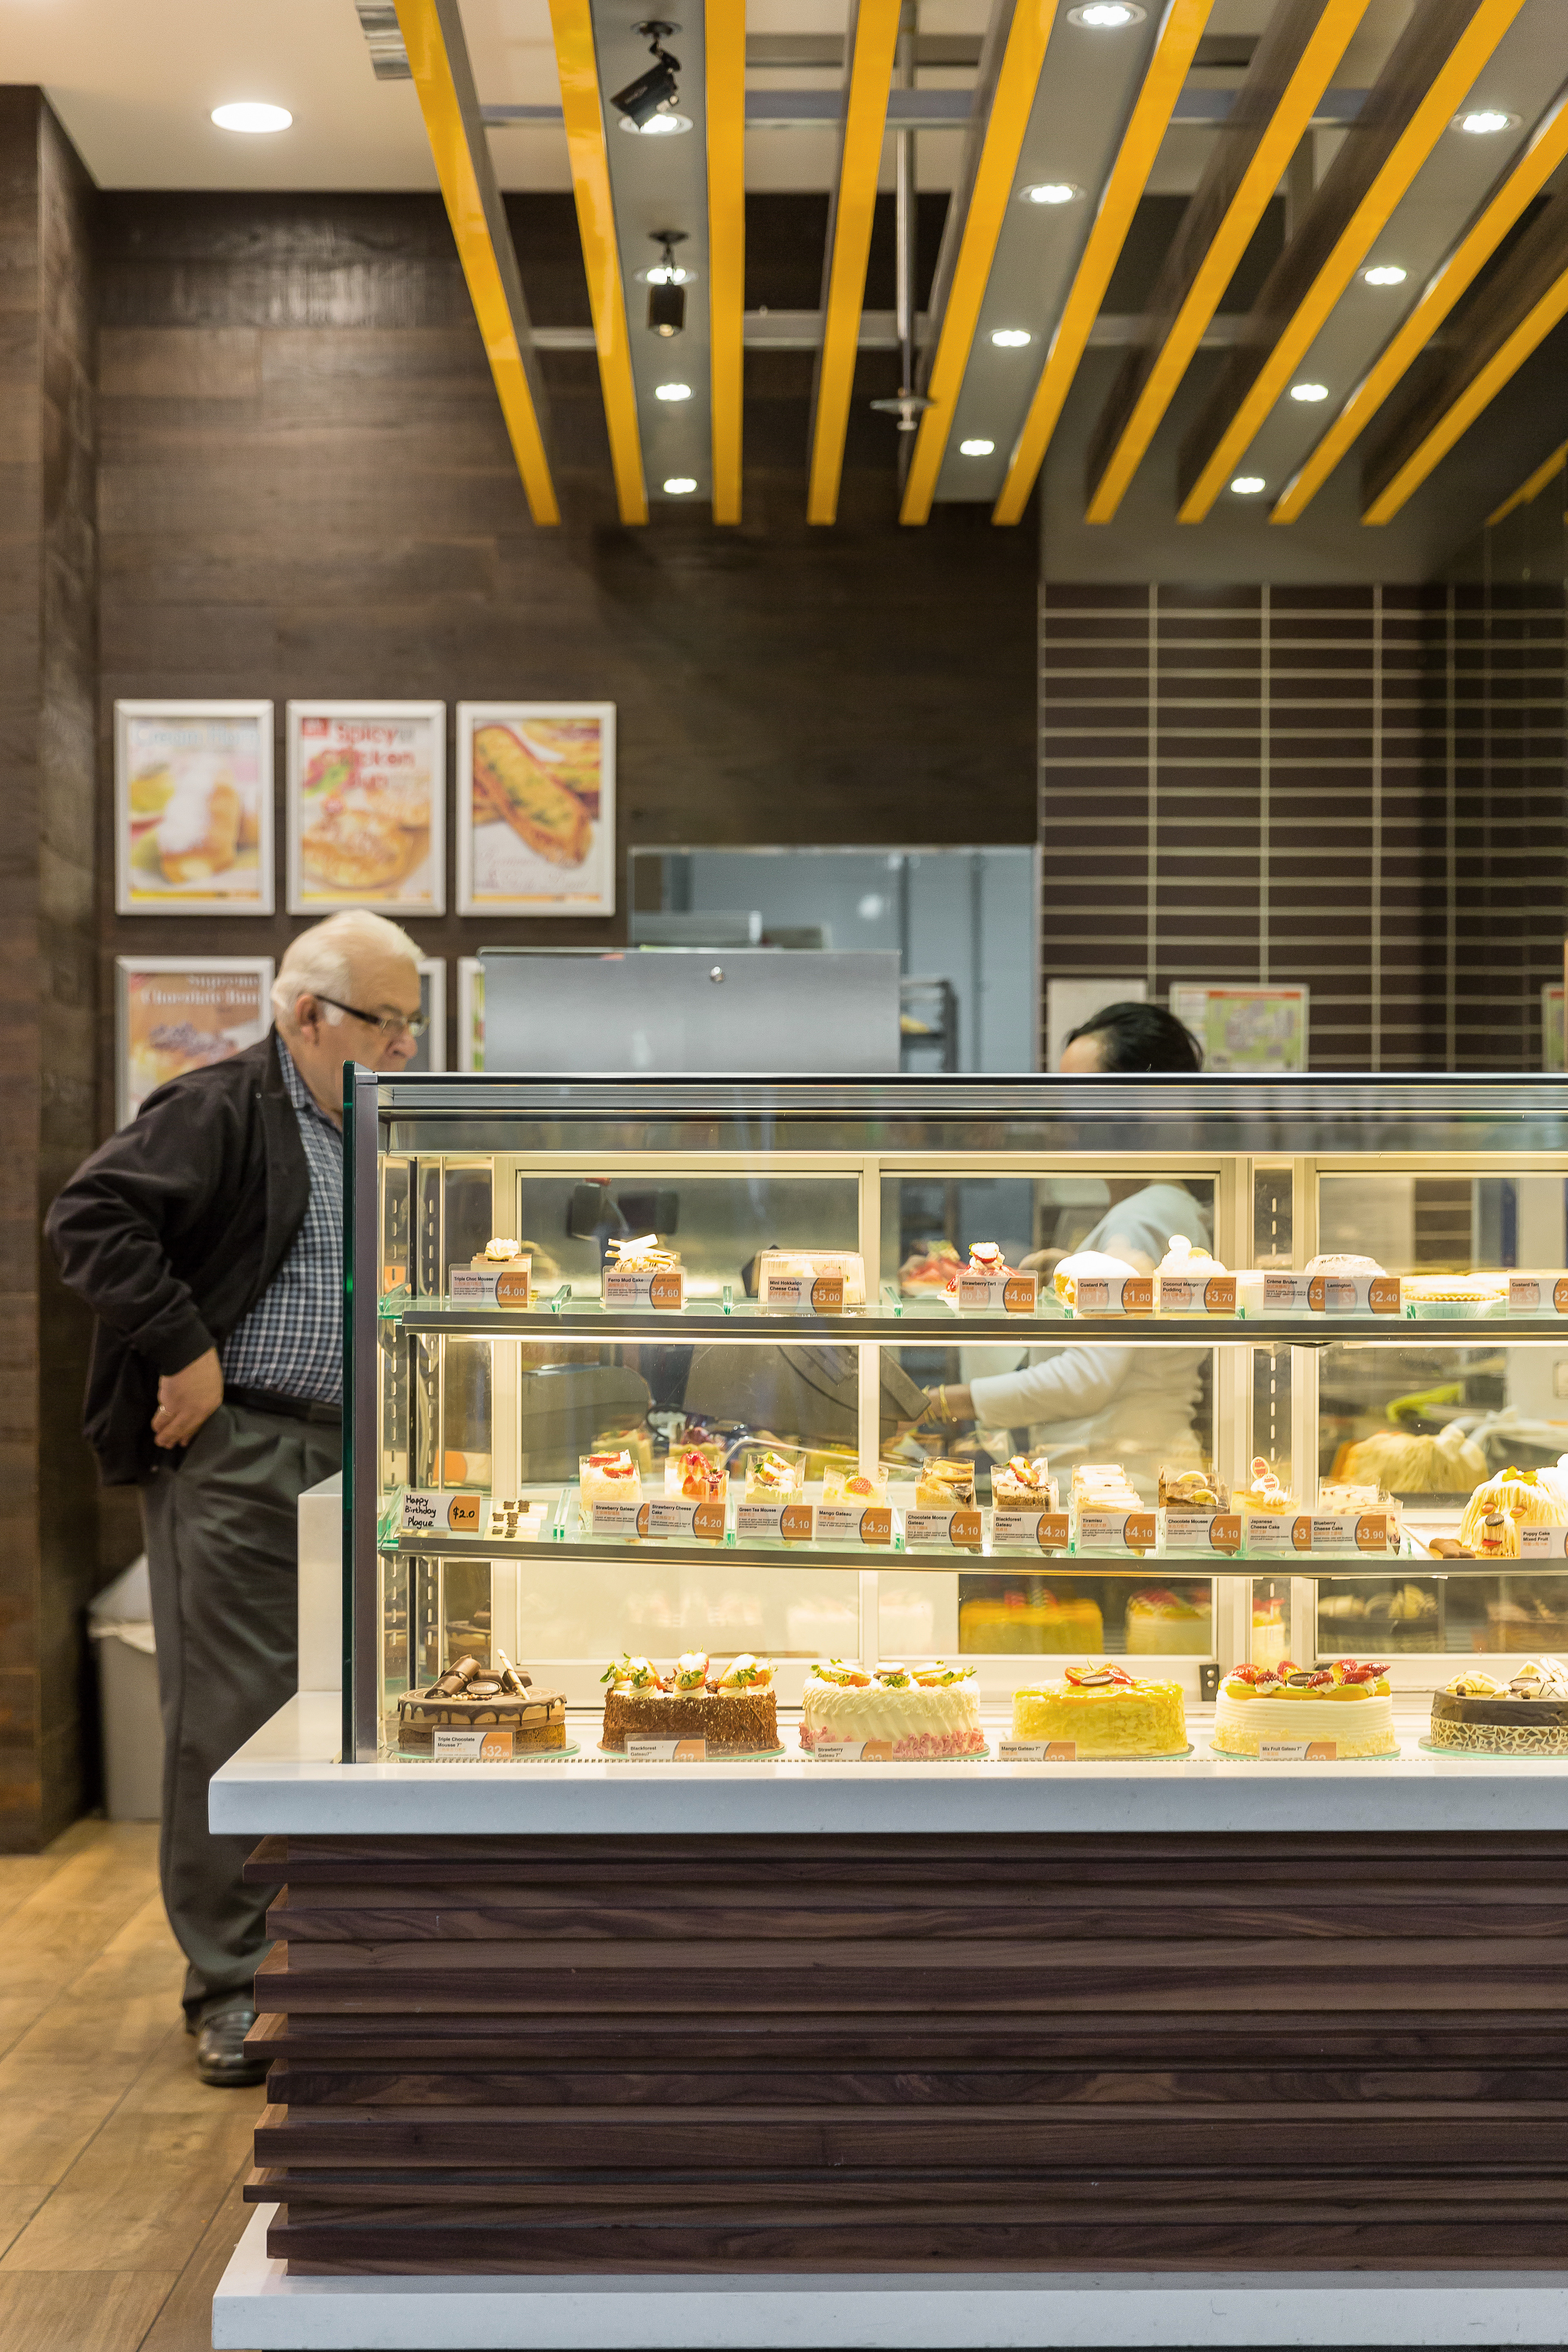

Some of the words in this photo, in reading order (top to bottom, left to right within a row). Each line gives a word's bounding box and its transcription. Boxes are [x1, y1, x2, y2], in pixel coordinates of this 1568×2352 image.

[498, 1285, 525, 1296] $4.00
[813, 1290, 840, 1301] $5.00
[1005, 1290, 1032, 1302] $4.00
[1123, 1290, 1151, 1302] $1.90
[1206, 1290, 1233, 1302] $3.70
[1370, 1291, 1397, 1302] $2.40
[406, 1494, 429, 1506] Happy
[405, 1505, 436, 1518] Birthday
[452, 1506, 475, 1520] $2.0
[695, 1515, 722, 1528] $4.20
[782, 1517, 809, 1529] $4.10
[862, 1521, 889, 1533] $4.20
[951, 1523, 978, 1535] $4.10
[1038, 1526, 1066, 1537] $4.20
[1125, 1526, 1153, 1538] $4.10
[1211, 1527, 1238, 1538] $4.10
[1357, 1528, 1384, 1539] $3.90
[481, 1745, 509, 1757] $32.00
